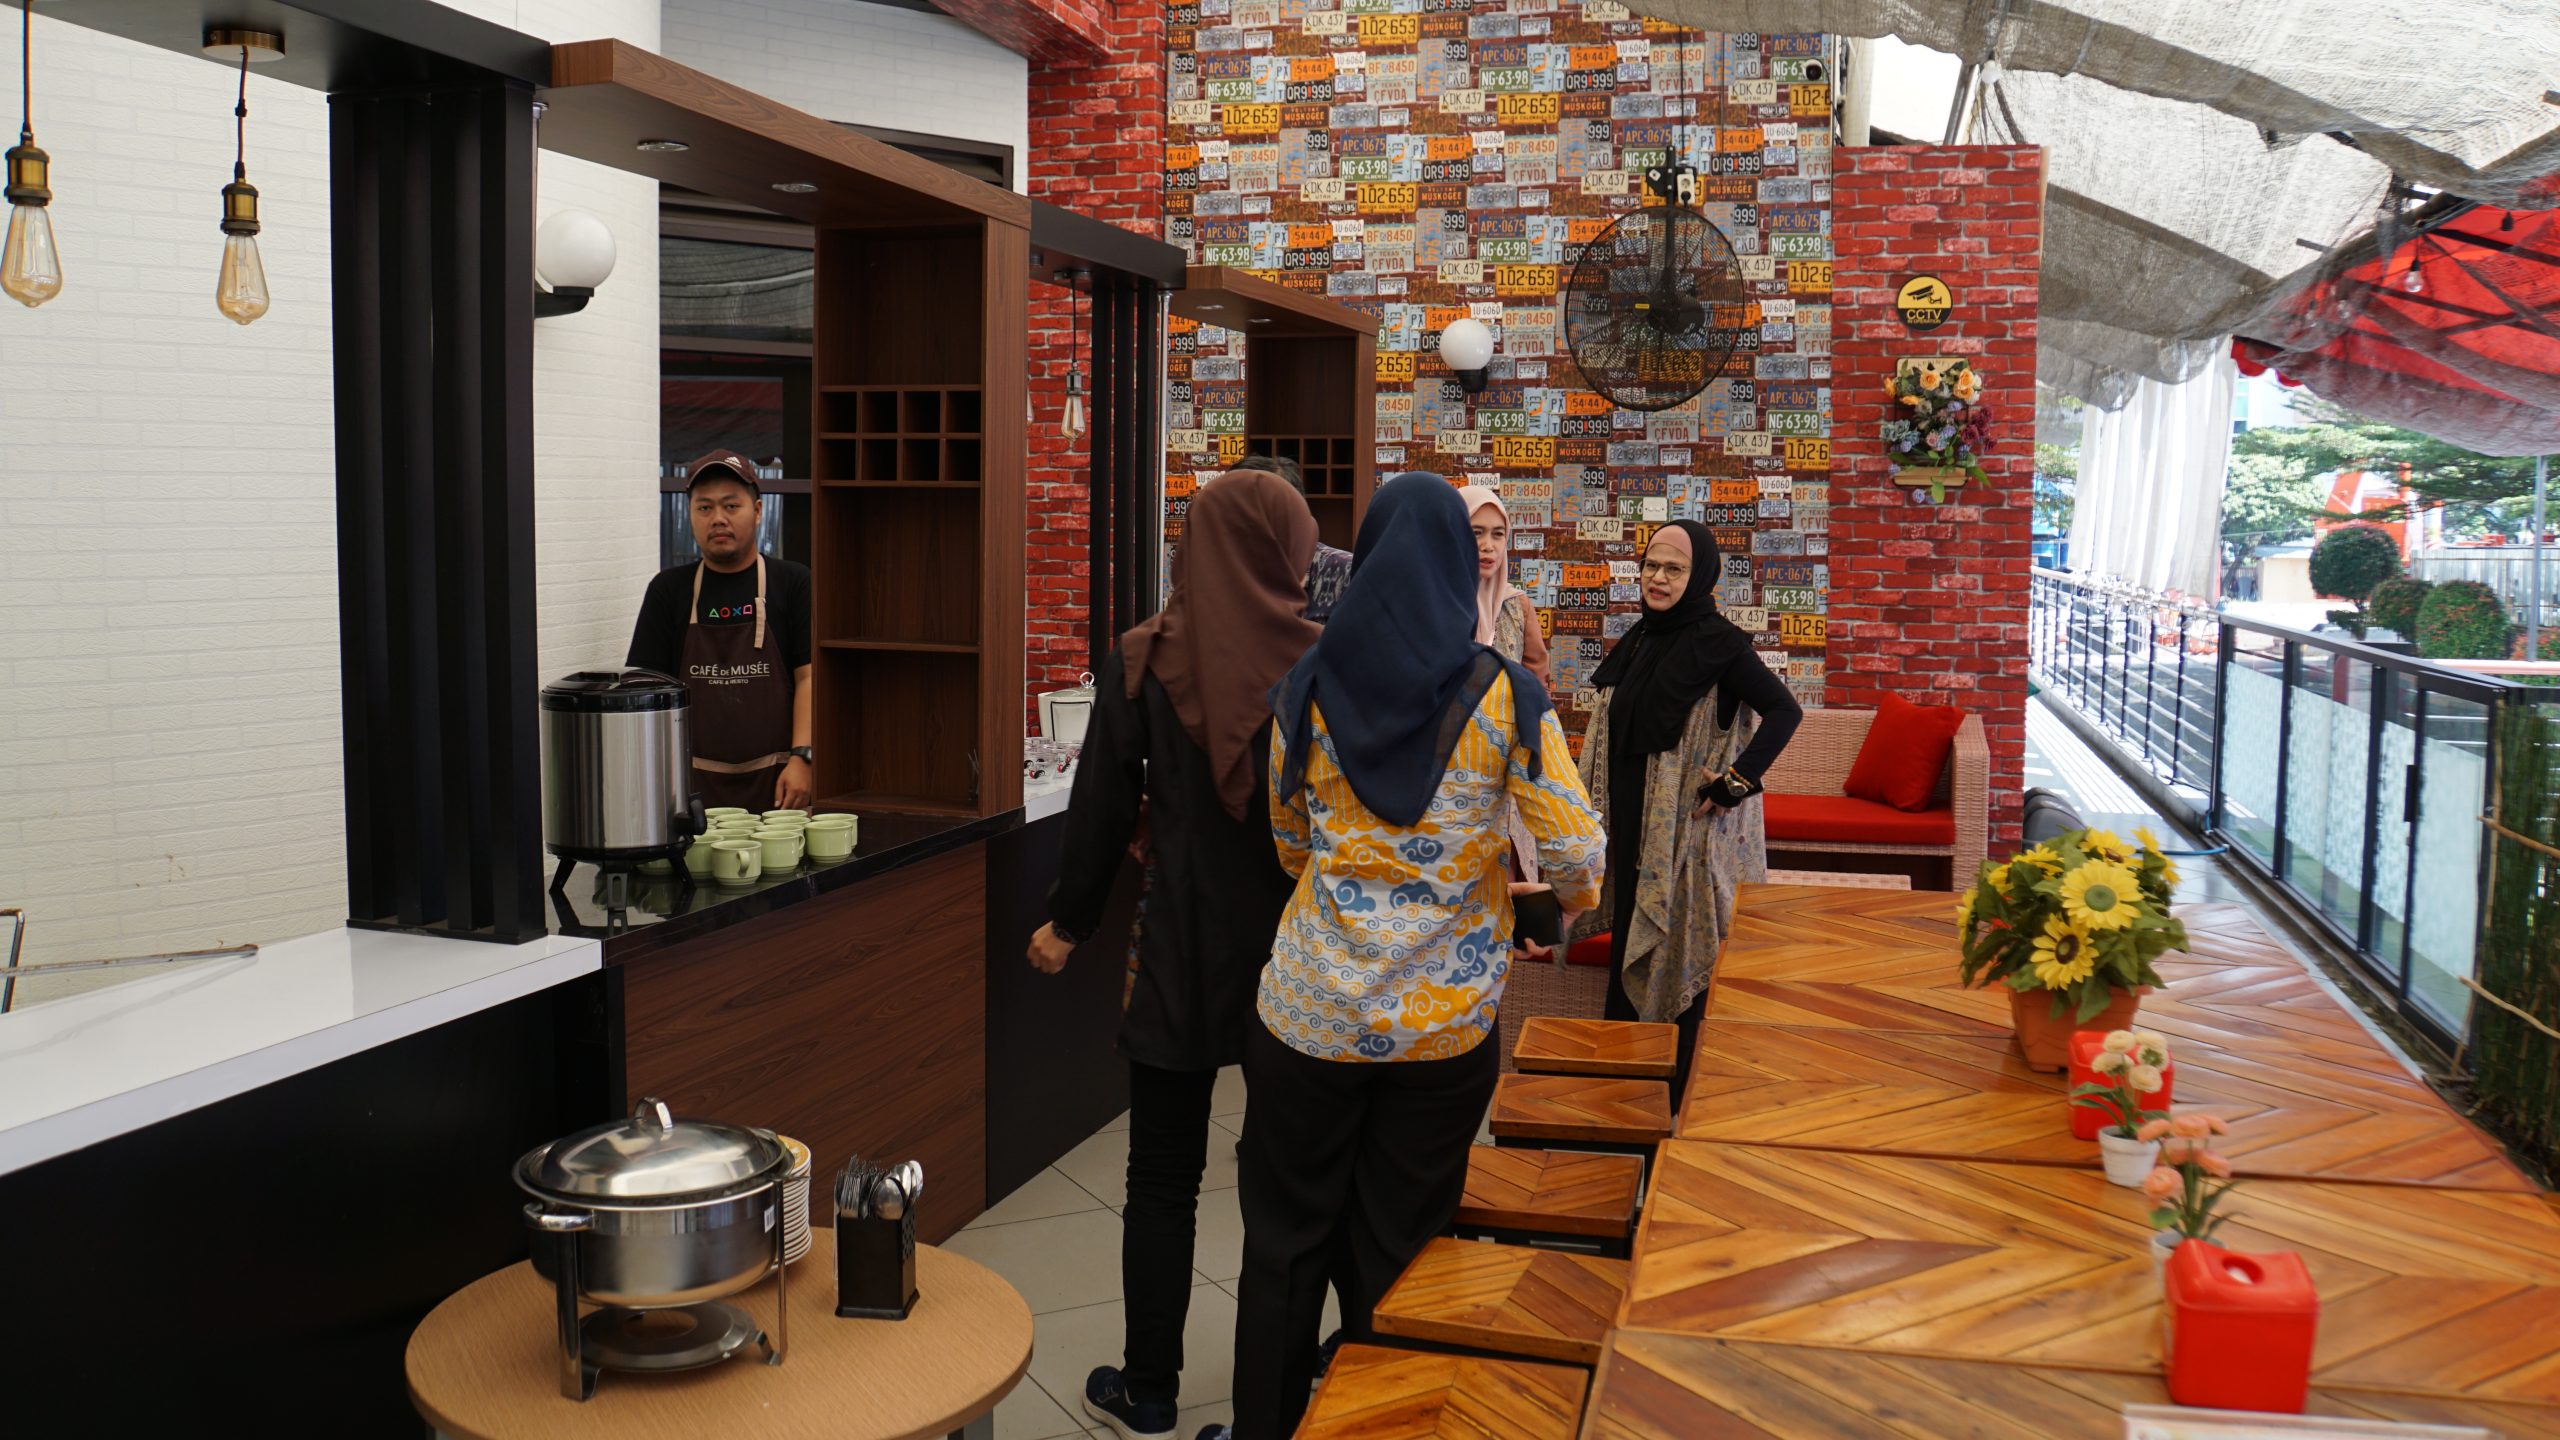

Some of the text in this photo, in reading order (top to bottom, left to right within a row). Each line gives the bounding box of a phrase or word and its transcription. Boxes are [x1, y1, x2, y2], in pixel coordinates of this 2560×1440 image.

[1306, 14, 1344, 27] KDK 437
[1555, 54, 1569, 68] PX
[1653, 50, 1666, 64] BF
[1277, 65, 1289, 79] PX
[1368, 60, 1415, 75] BF 8450
[1733, 82, 1774, 96] KDK 437
[1443, 93, 1482, 106] KDK 437
[1172, 103, 1208, 115] KDK 437
[1700, 136, 1714, 150] PX
[1801, 132, 1815, 146] BF
[1413, 144, 1426, 159] PX
[1507, 140, 1555, 155] BF 8450
[1232, 149, 1277, 163] BF 8450
[1584, 174, 1625, 187] KDK 437
[1304, 182, 1342, 194] KDK 437
[1275, 232, 1288, 246] PX
[1366, 230, 1413, 243] BF 8450
[1553, 226, 1566, 241] PX
[1441, 264, 1480, 276] KDK 437
[1754, 259, 1772, 271] 437
[1411, 314, 1424, 328] PX
[1505, 313, 1553, 326] BF 8450
[1798, 310, 1812, 323] BF
[1907, 309, 1942, 320] CCTV
[1384, 399, 1410, 411] 8450
[1551, 398, 1564, 413] PX
[1168, 432, 1205, 444] KDK 437
[1439, 433, 1478, 446] KDK 437
[1727, 434, 1769, 447] KDK 437
[1503, 484, 1550, 497] BF 8450
[1695, 485, 1709, 500] PX
[1796, 486, 1810, 500] BF
[1579, 520, 1620, 532] KDK 437
[1548, 570, 1562, 584] PX
[1749, 610, 1766, 622] 437
[690, 664, 718, 676] CAFÉ
[731, 661, 770, 676] MUSÉE
